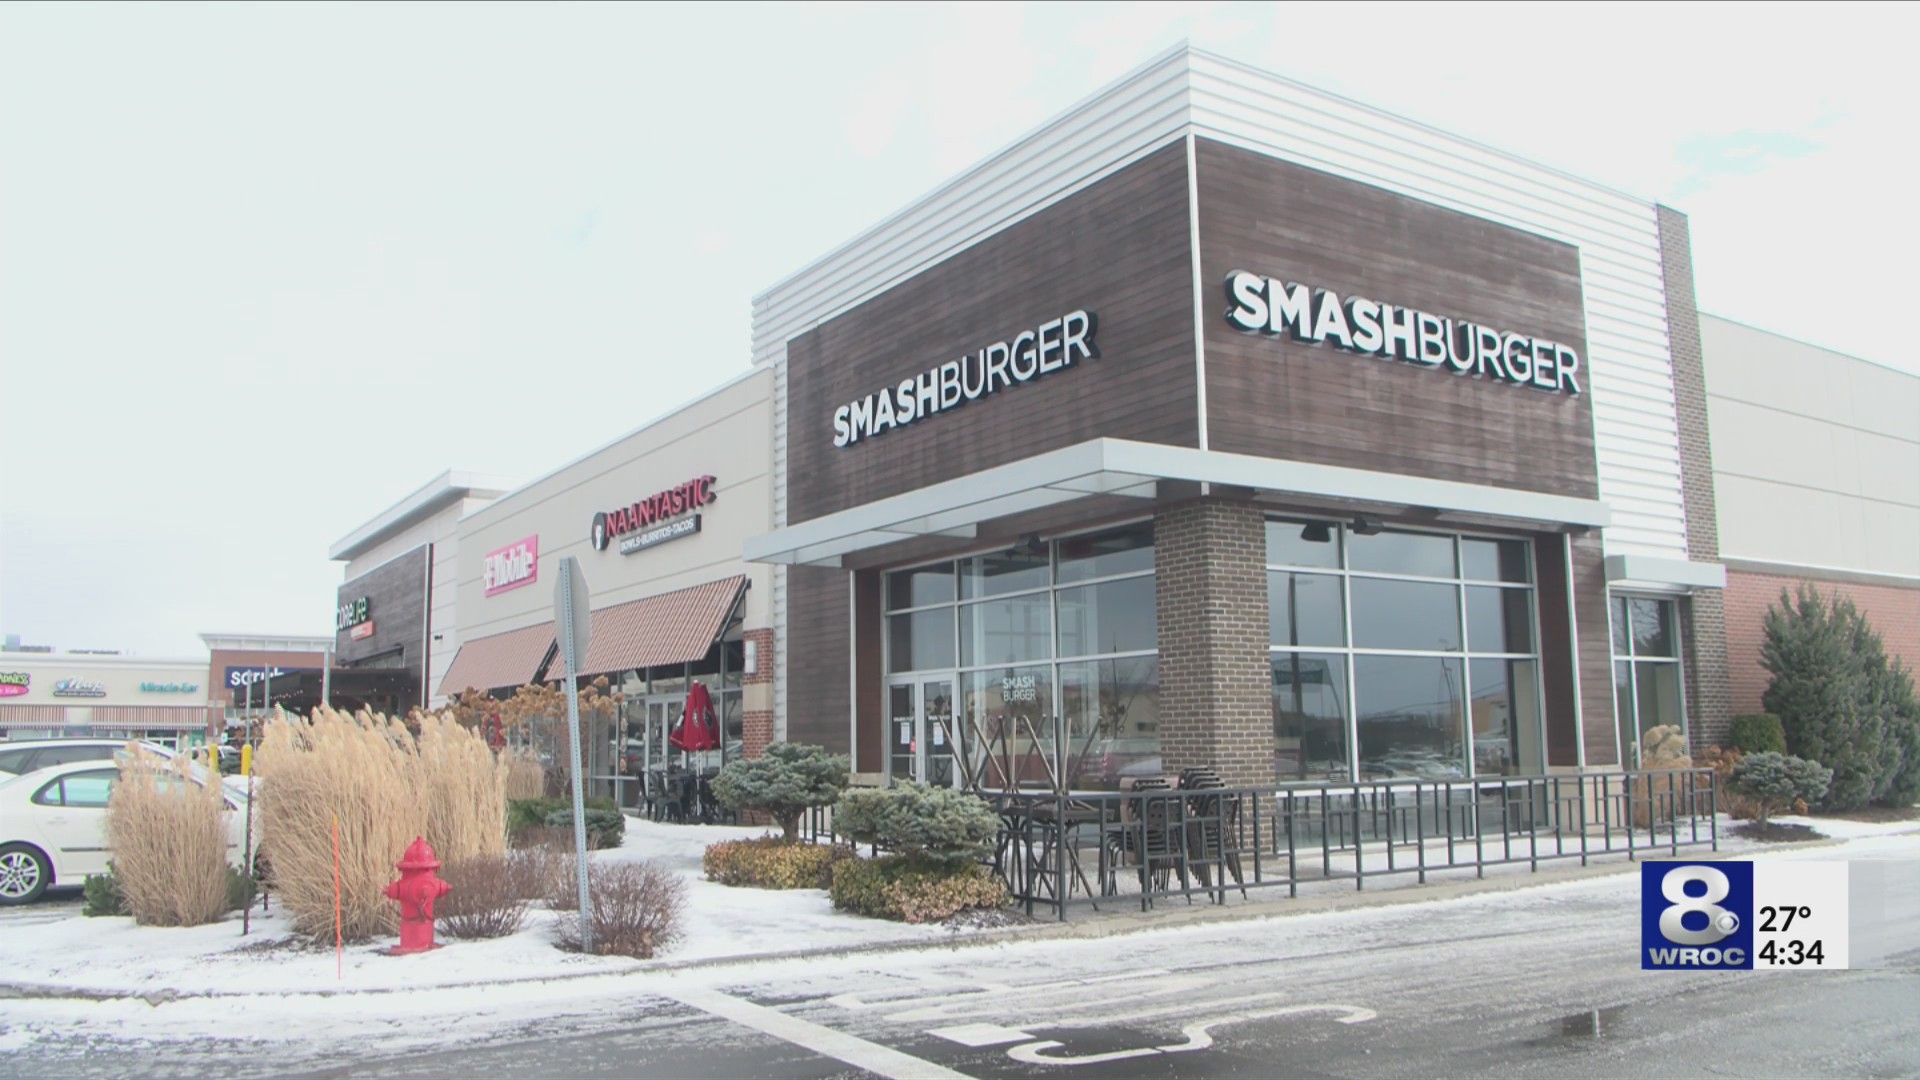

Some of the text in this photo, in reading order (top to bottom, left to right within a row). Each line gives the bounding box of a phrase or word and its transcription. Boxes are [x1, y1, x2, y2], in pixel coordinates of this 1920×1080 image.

[1232, 273, 1581, 392] SMASHBURGER
[833, 309, 1092, 447] SMASHBURGER
[1002, 675, 1036, 689] SMASH
[1003, 688, 1036, 701] BURGER
